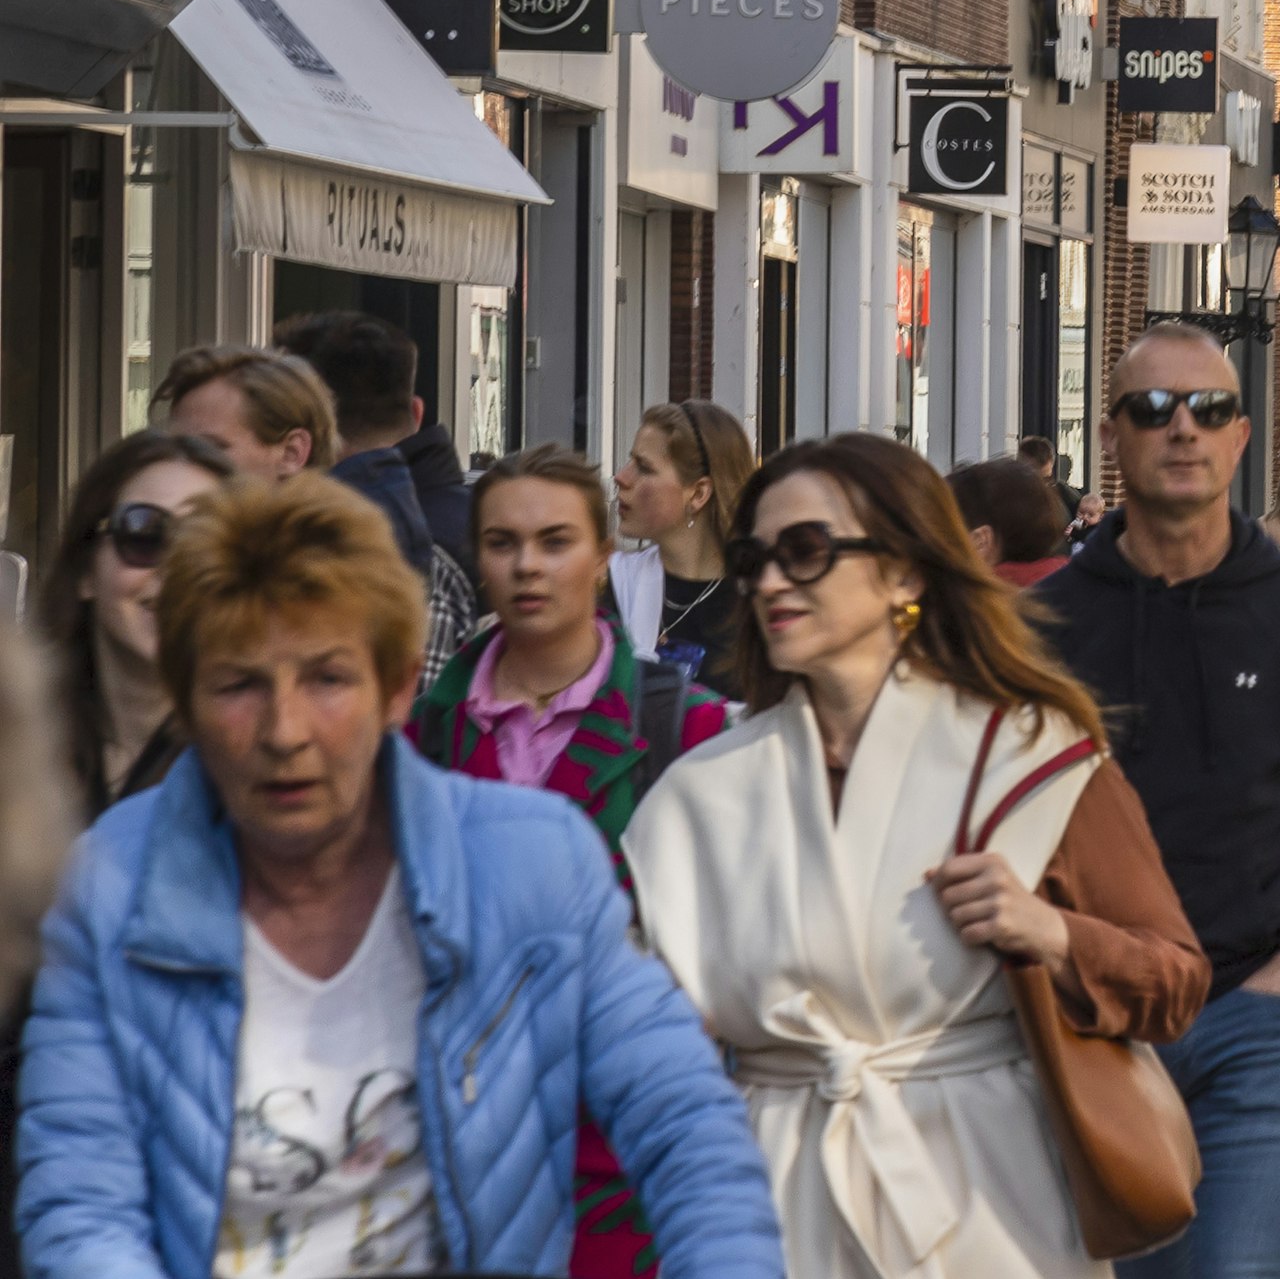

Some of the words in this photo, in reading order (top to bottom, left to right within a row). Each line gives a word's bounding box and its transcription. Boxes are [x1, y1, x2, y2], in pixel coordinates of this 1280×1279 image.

[1124, 48, 1204, 85] snipes
[1140, 173, 1216, 189] SCOTCH
[1162, 189, 1216, 205] SODA
